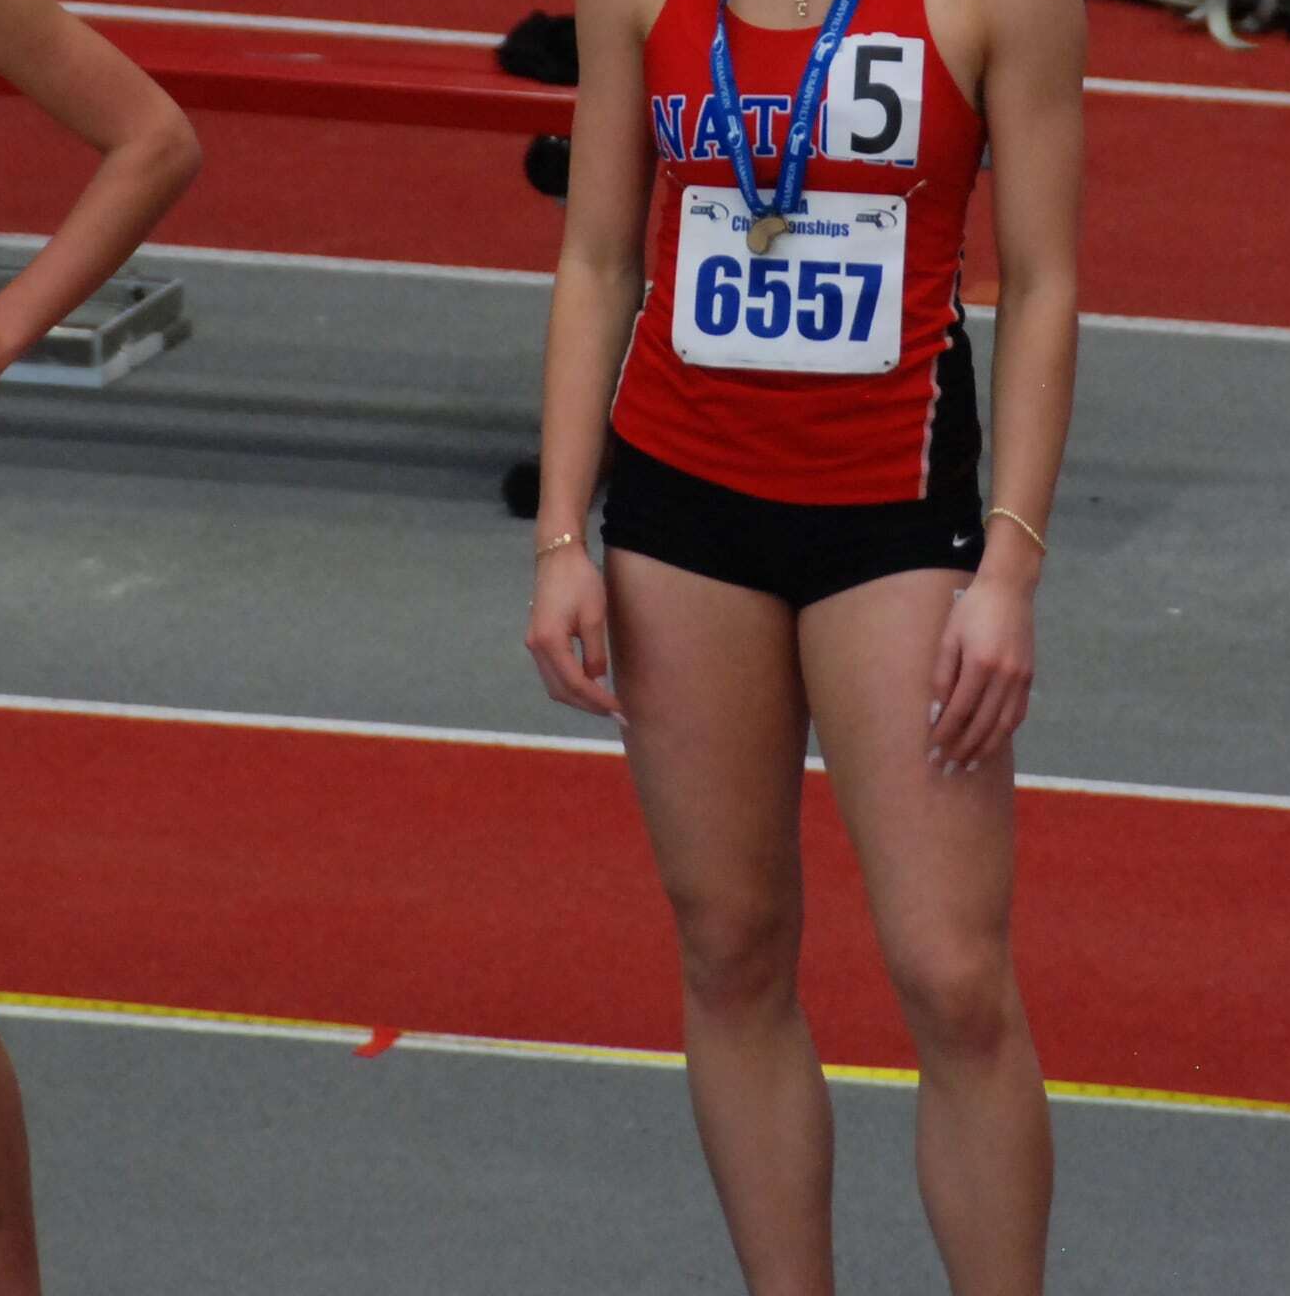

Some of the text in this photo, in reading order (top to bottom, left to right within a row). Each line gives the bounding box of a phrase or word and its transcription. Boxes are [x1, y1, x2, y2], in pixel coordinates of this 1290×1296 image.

[799, 67, 821, 121] CHAMPION
[850, 45, 904, 155] 5
[694, 254, 883, 342] 6557
